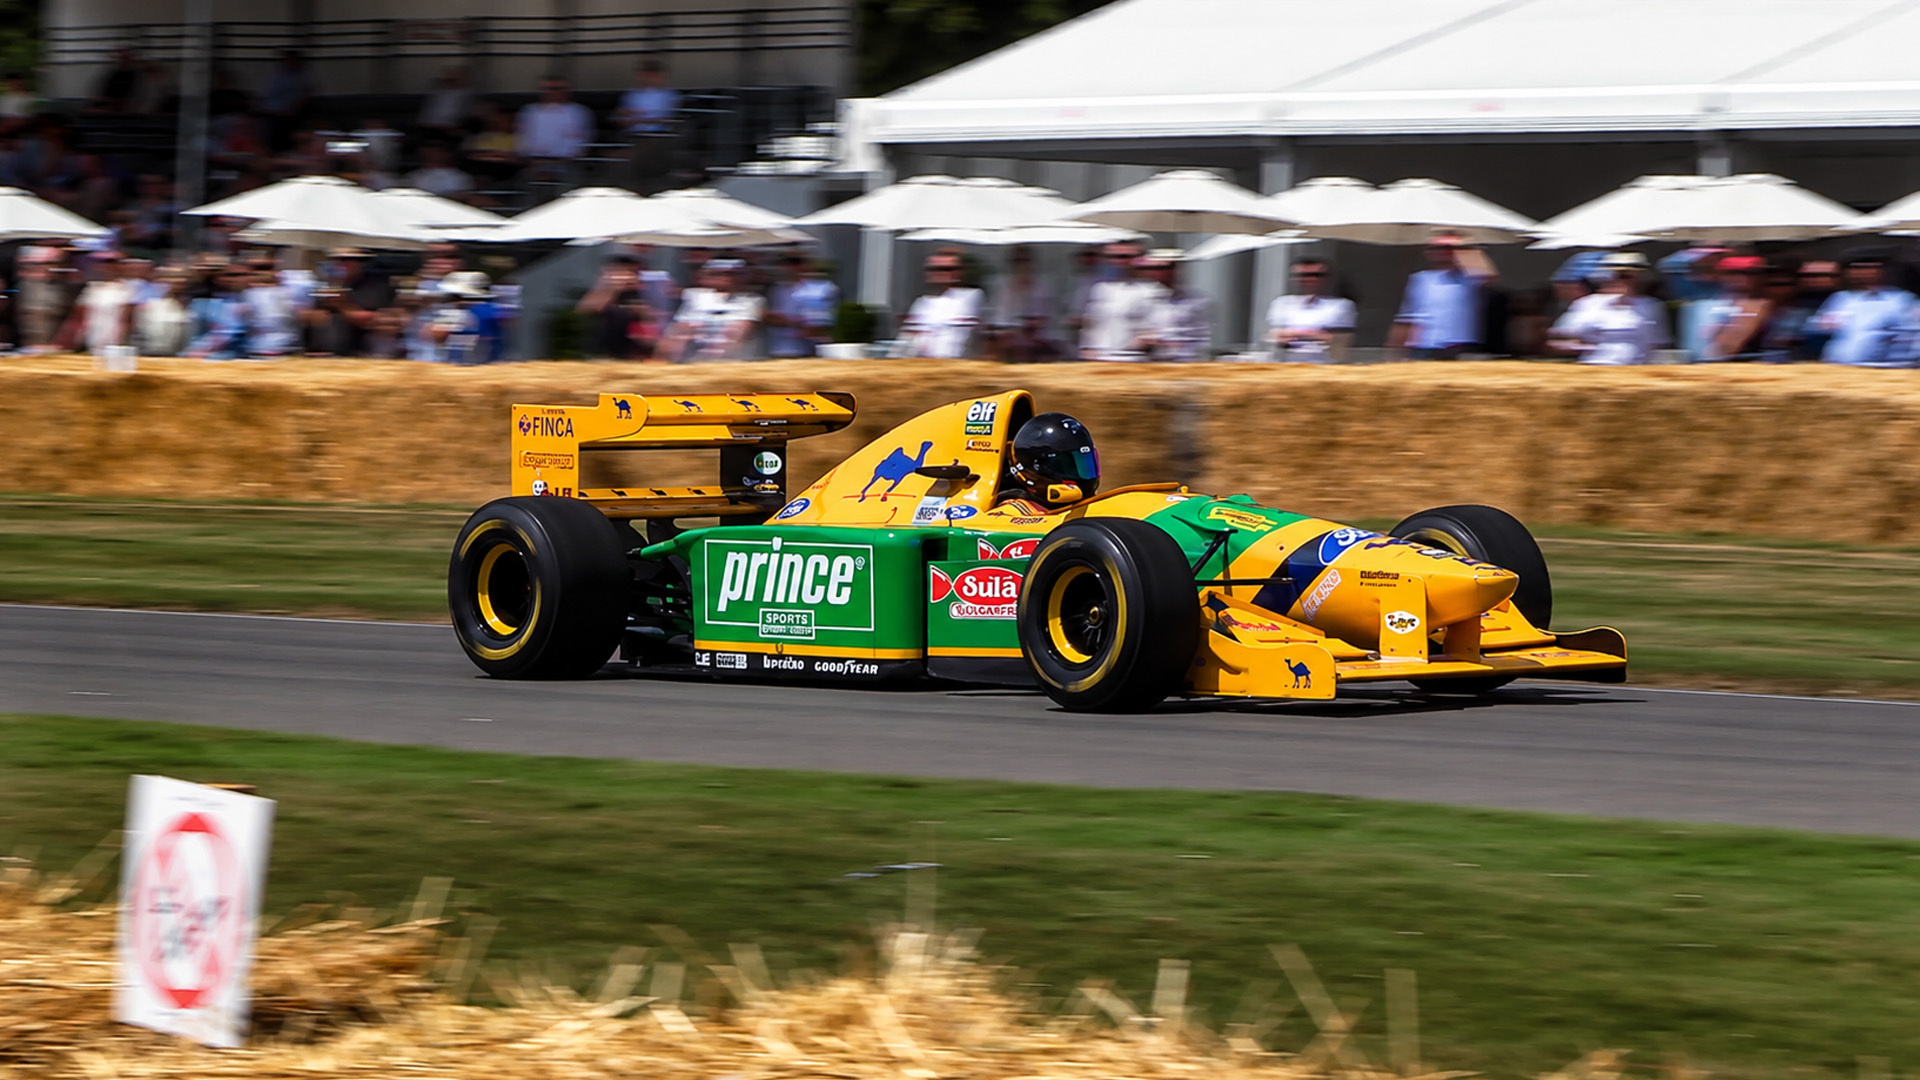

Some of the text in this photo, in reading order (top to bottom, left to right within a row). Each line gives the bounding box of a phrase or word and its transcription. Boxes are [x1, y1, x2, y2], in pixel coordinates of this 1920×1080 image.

[967, 402, 997, 422] elf
[532, 416, 574, 437] FINCA
[765, 612, 808, 625] SPORTS
[814, 659, 879, 675] GOODYEAR
